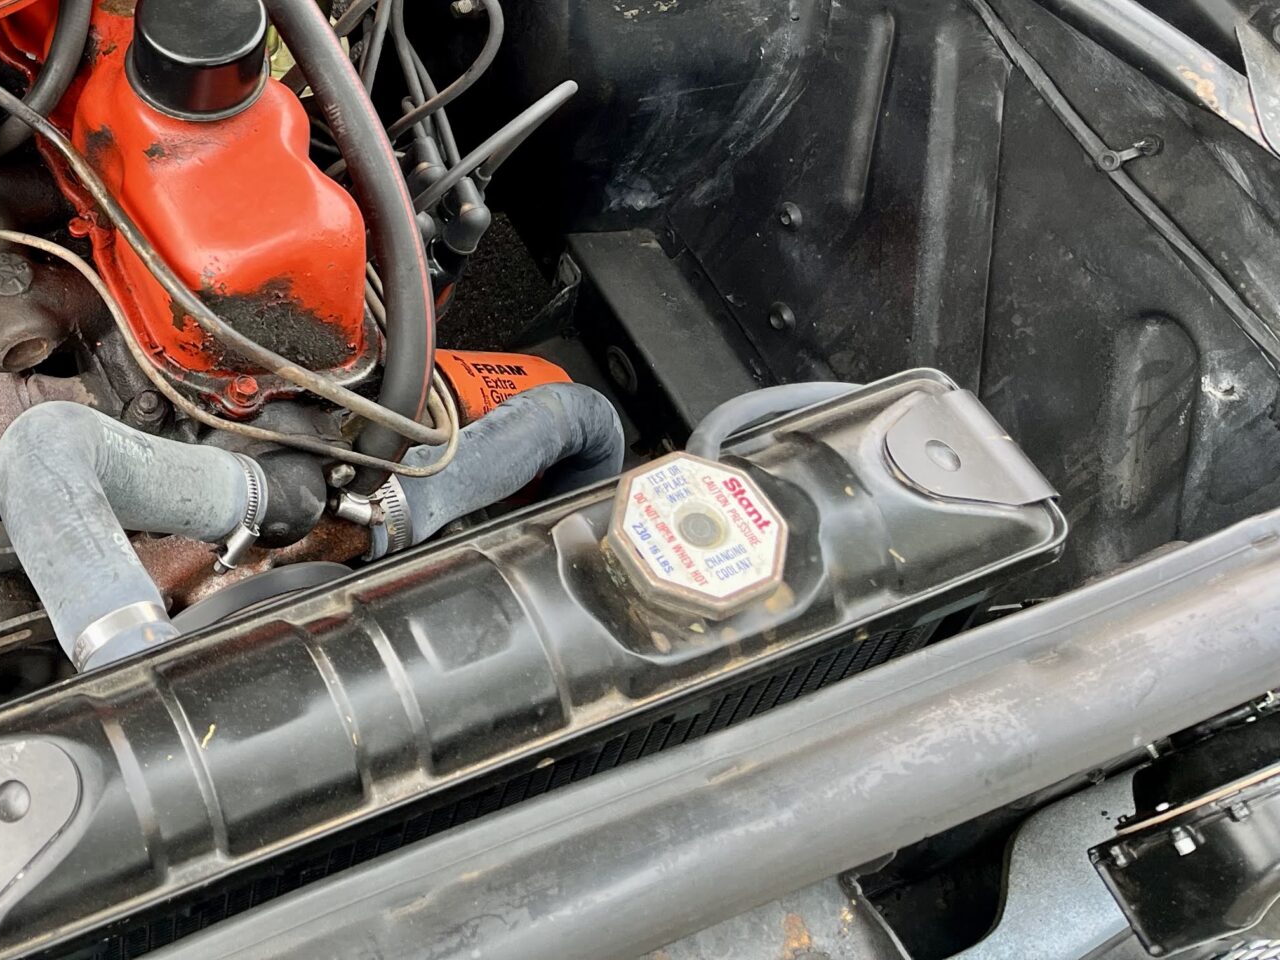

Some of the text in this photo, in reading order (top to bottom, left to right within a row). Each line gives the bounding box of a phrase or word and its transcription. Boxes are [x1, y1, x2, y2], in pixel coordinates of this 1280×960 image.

[471, 362, 528, 376] FRAM
[482, 376, 517, 390] Extra
[647, 465, 681, 486] TEST OR
[654, 475, 688, 496] REPLACE
[666, 487, 691, 504] WHEN
[722, 477, 771, 534] Stant
[702, 475, 761, 546] CAUTION PRESSURE
[632, 522, 651, 542] 230
[656, 555, 674, 574] LBS
[633, 492, 709, 586] DO NOT OPEN WHEN HOT
[704, 543, 748, 569] CHANGING
[715, 557, 753, 581] COOLANT
